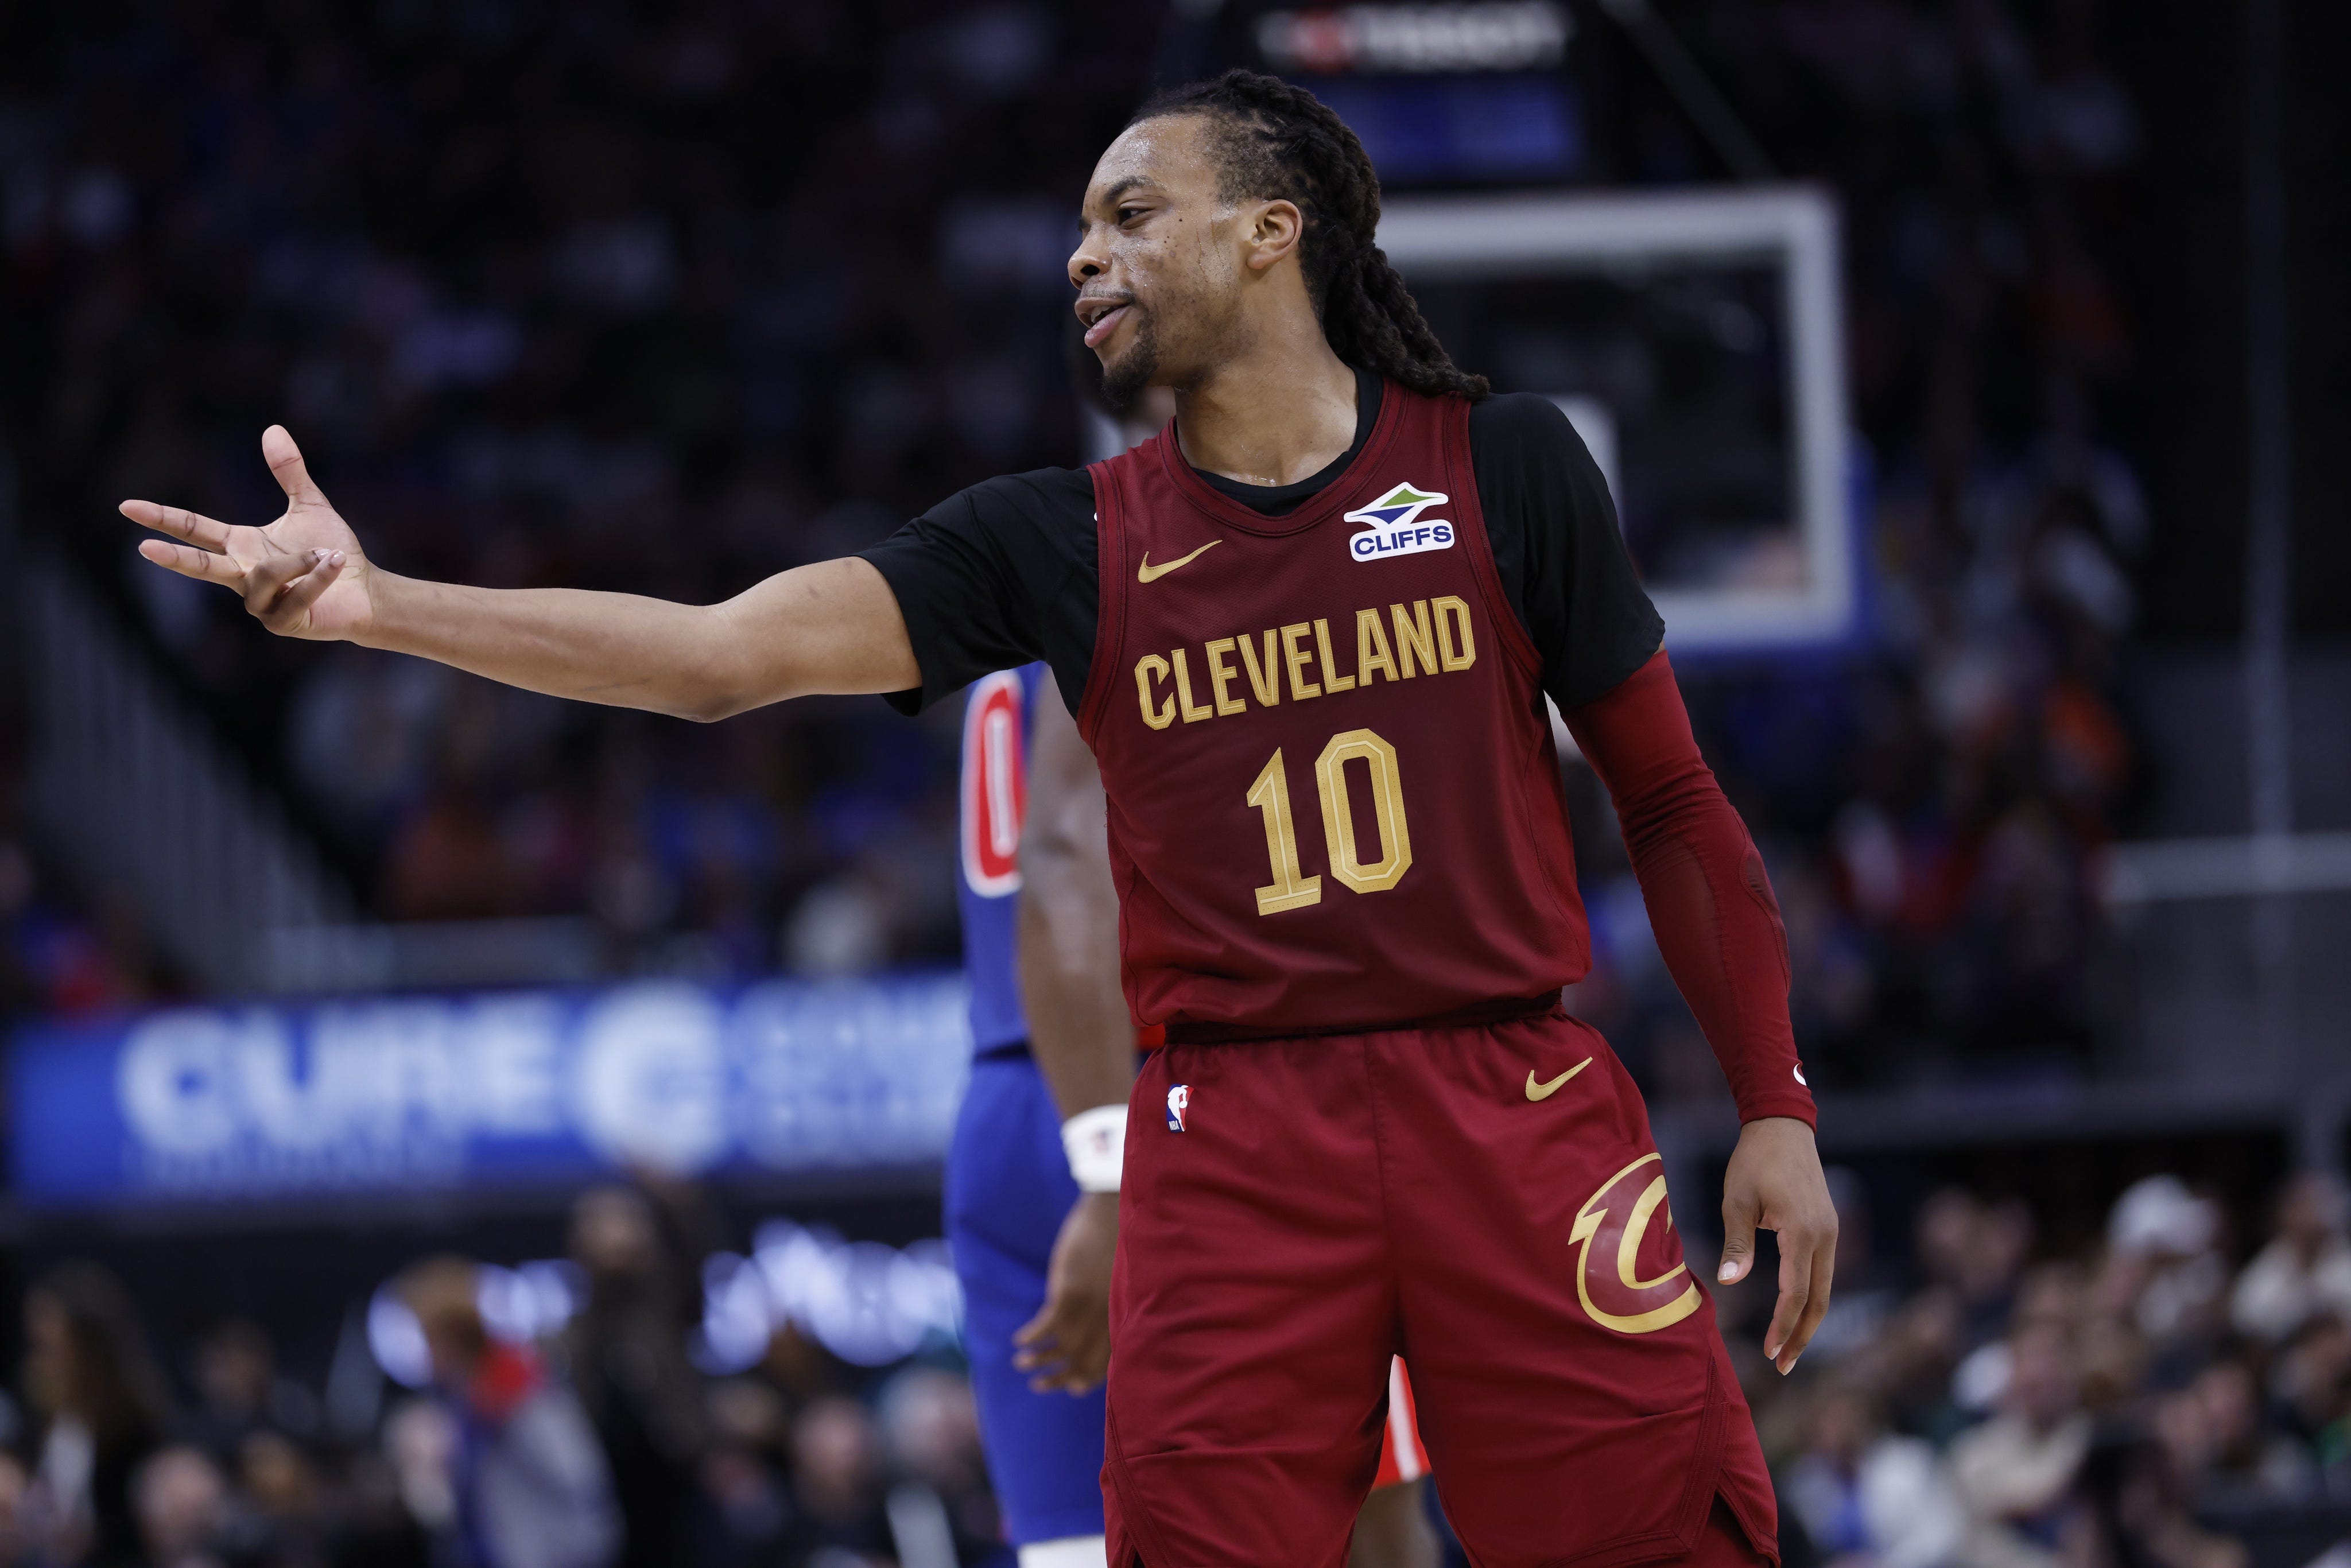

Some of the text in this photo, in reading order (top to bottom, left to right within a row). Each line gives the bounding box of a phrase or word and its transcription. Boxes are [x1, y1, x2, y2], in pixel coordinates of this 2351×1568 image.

[1354, 525, 1452, 555] CLIFFS
[1134, 595, 1476, 730] CLEVELAND
[1246, 728, 1413, 916] 10
[1169, 1120, 1180, 1131] NBA
